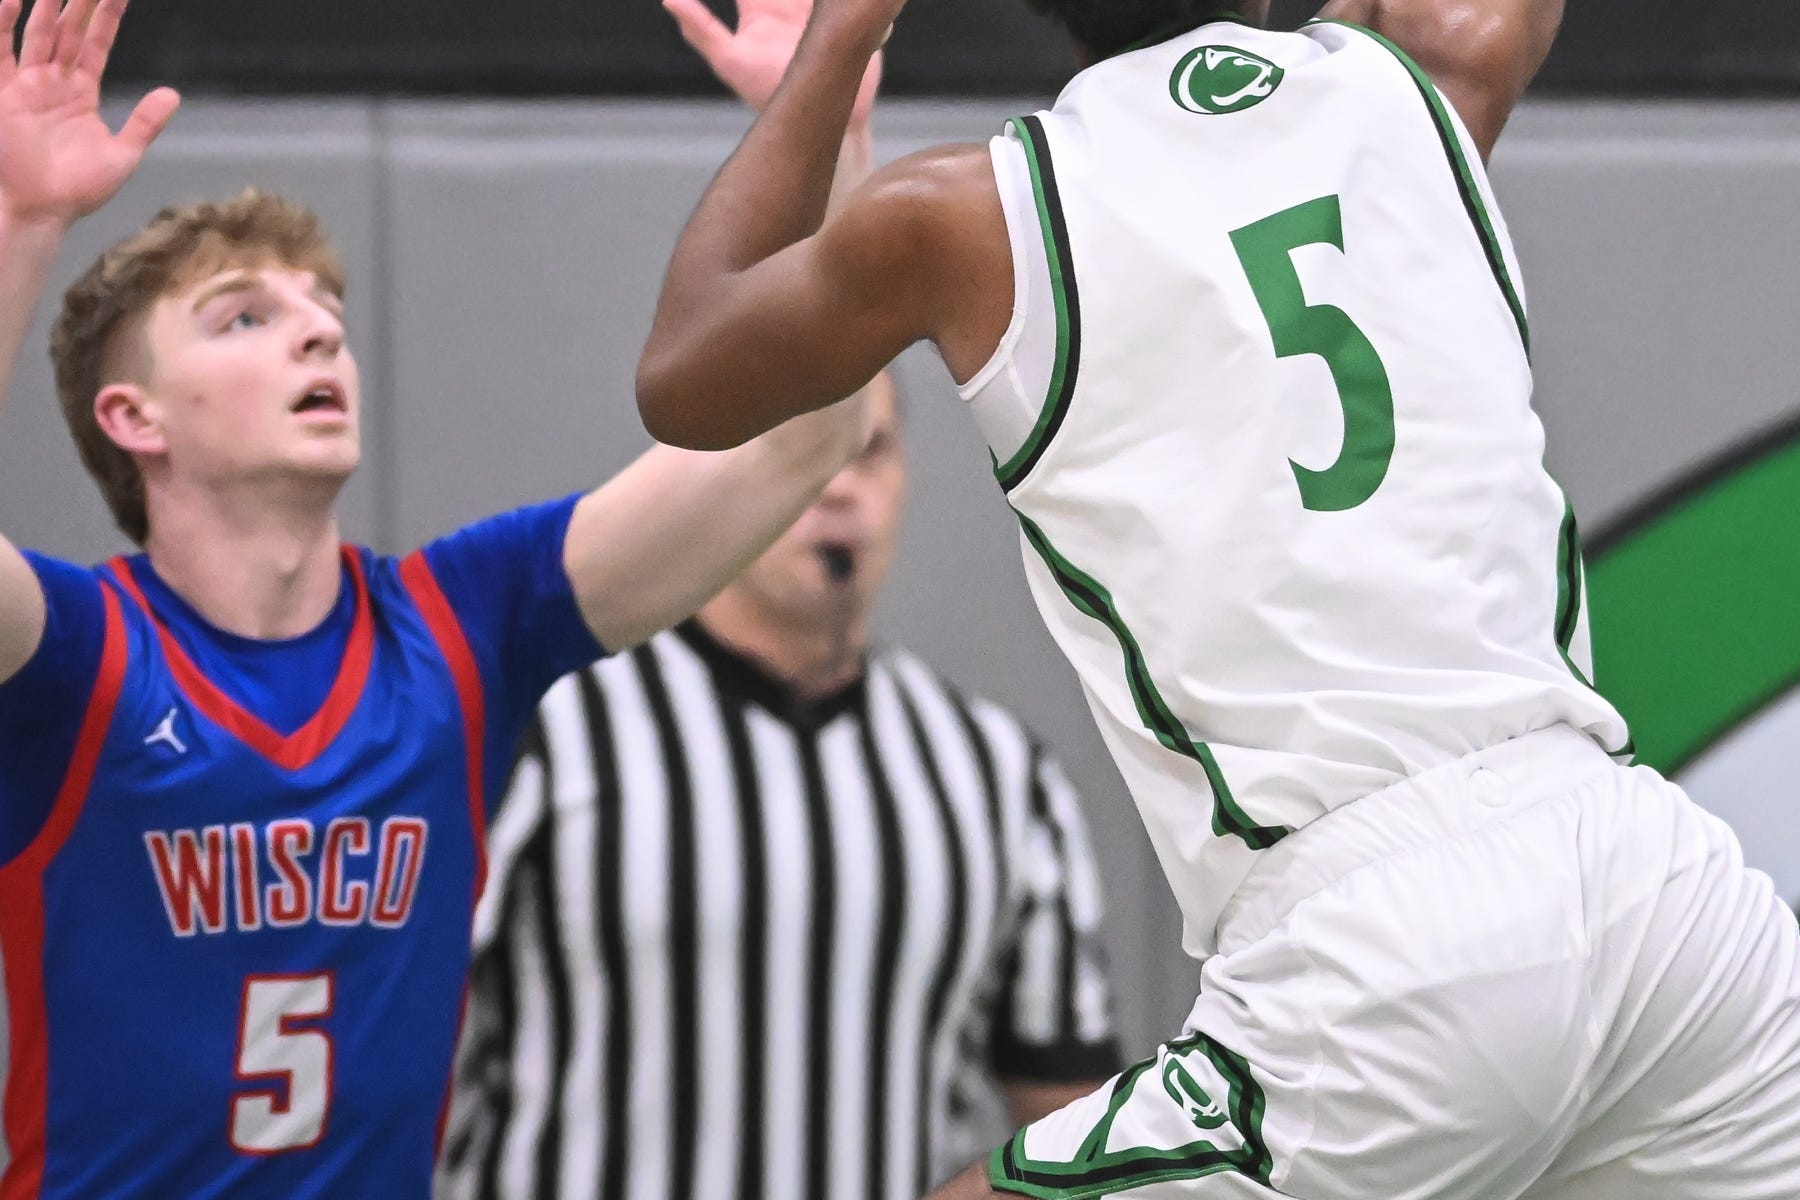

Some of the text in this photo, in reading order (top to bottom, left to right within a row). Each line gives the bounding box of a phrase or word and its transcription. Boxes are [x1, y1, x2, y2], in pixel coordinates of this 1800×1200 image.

[1228, 194, 1395, 511] 5
[145, 817, 427, 936] WISCO
[227, 970, 336, 1156] 5
